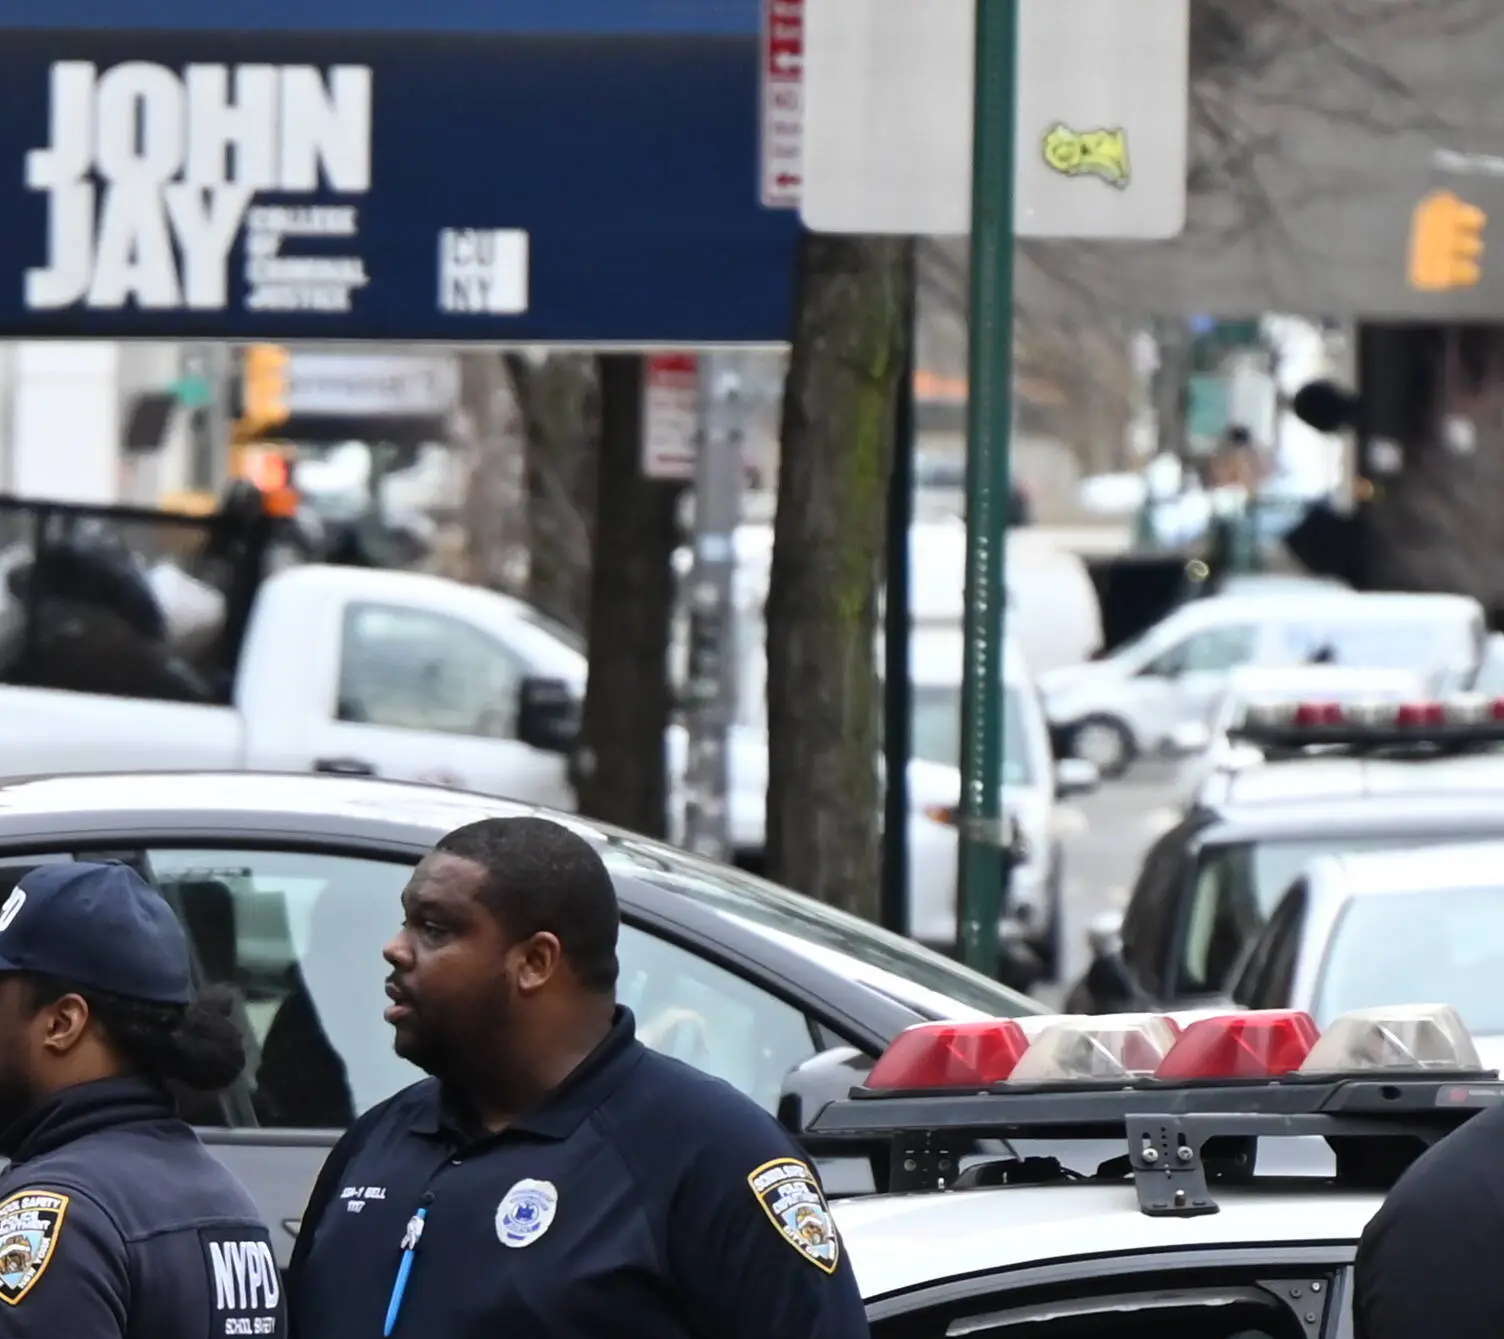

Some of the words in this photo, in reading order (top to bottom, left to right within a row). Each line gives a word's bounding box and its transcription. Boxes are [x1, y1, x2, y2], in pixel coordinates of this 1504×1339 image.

[26, 61, 373, 191] JOHN
[26, 186, 258, 310] JAY
[209, 1241, 279, 1310] NYPD
[225, 1318, 252, 1335] SCHOOL
